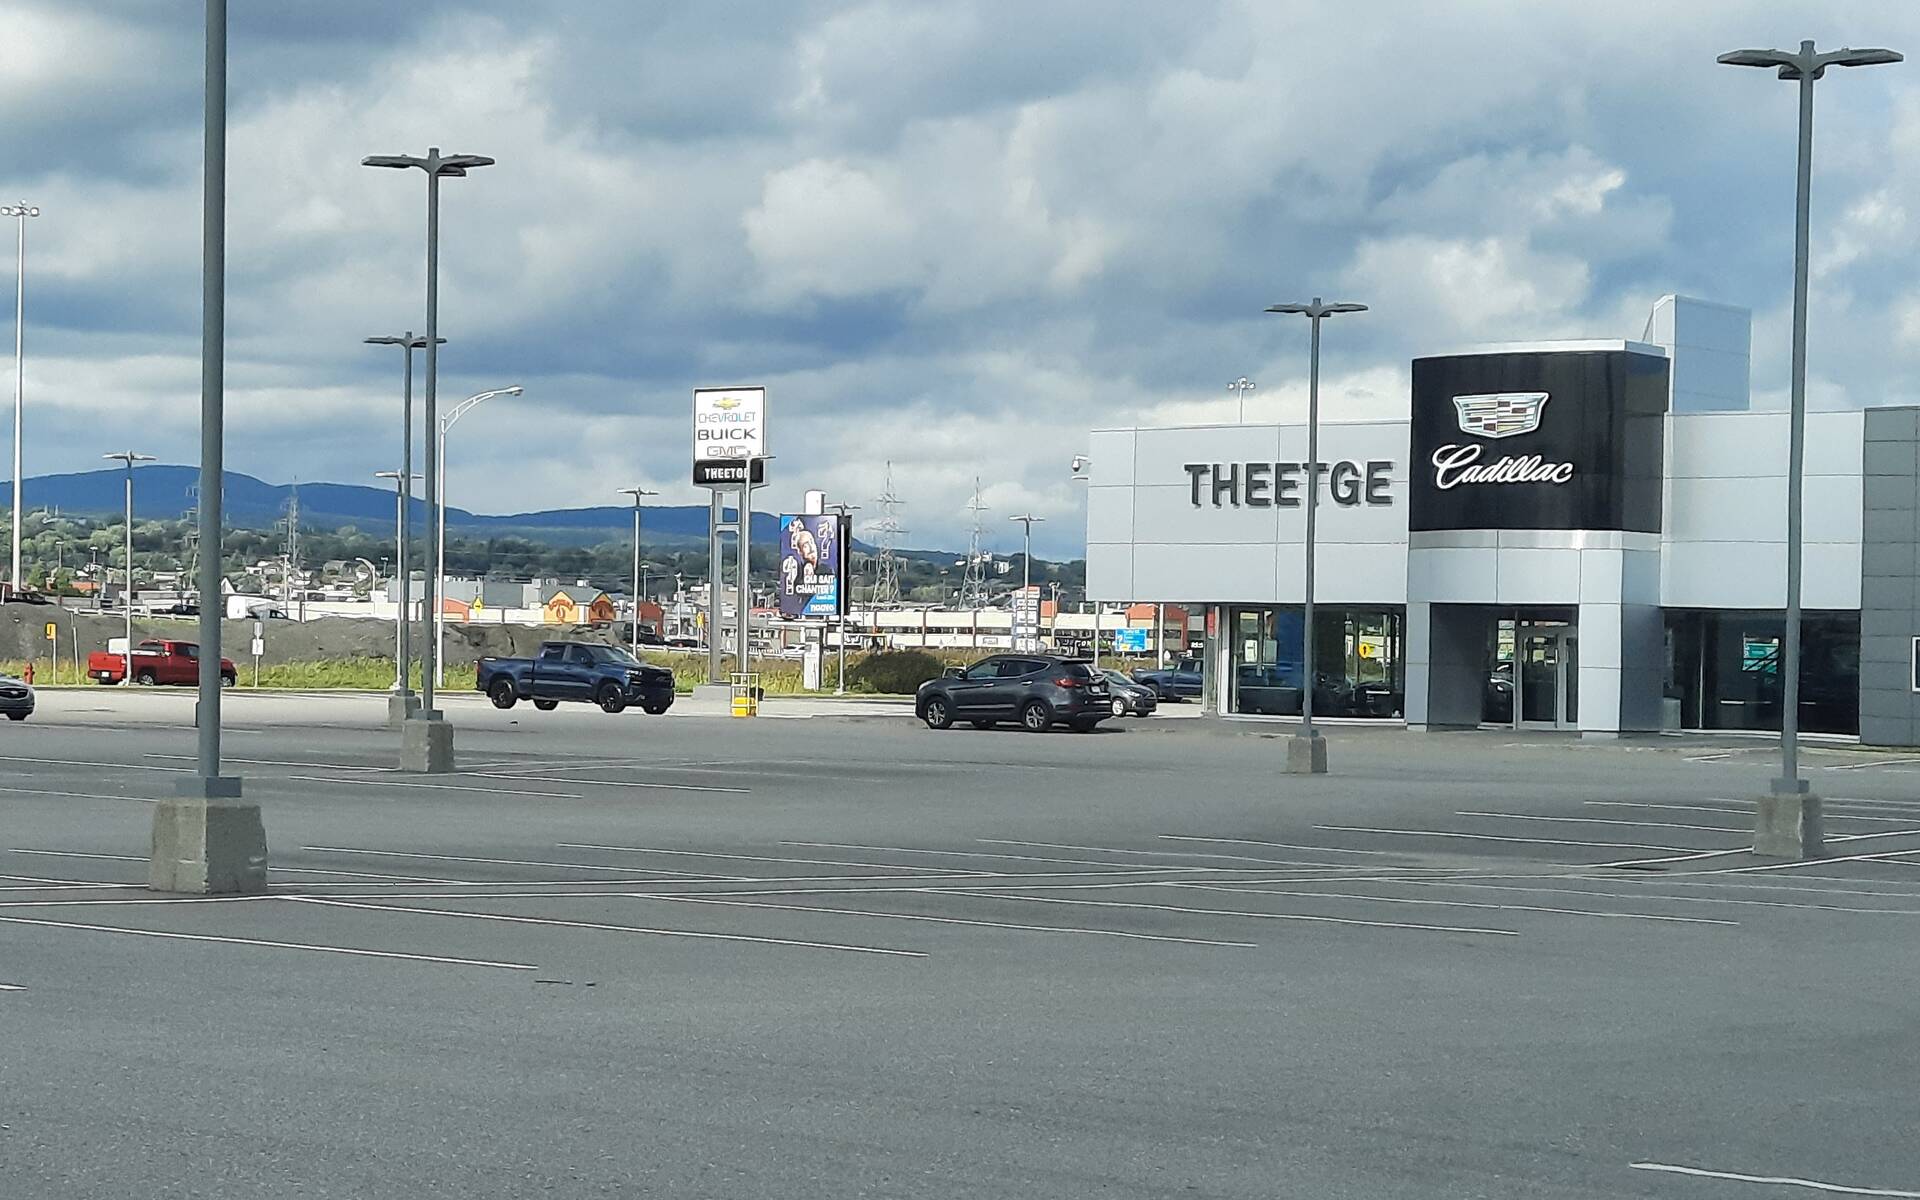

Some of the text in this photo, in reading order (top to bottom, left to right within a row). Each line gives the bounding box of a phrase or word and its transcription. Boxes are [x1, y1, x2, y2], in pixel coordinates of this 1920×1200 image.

[699, 412, 756, 423] CHEVROLET
[698, 428, 756, 440] BUICK
[707, 445, 748, 457] GMC
[1432, 444, 1574, 490] Cadillac
